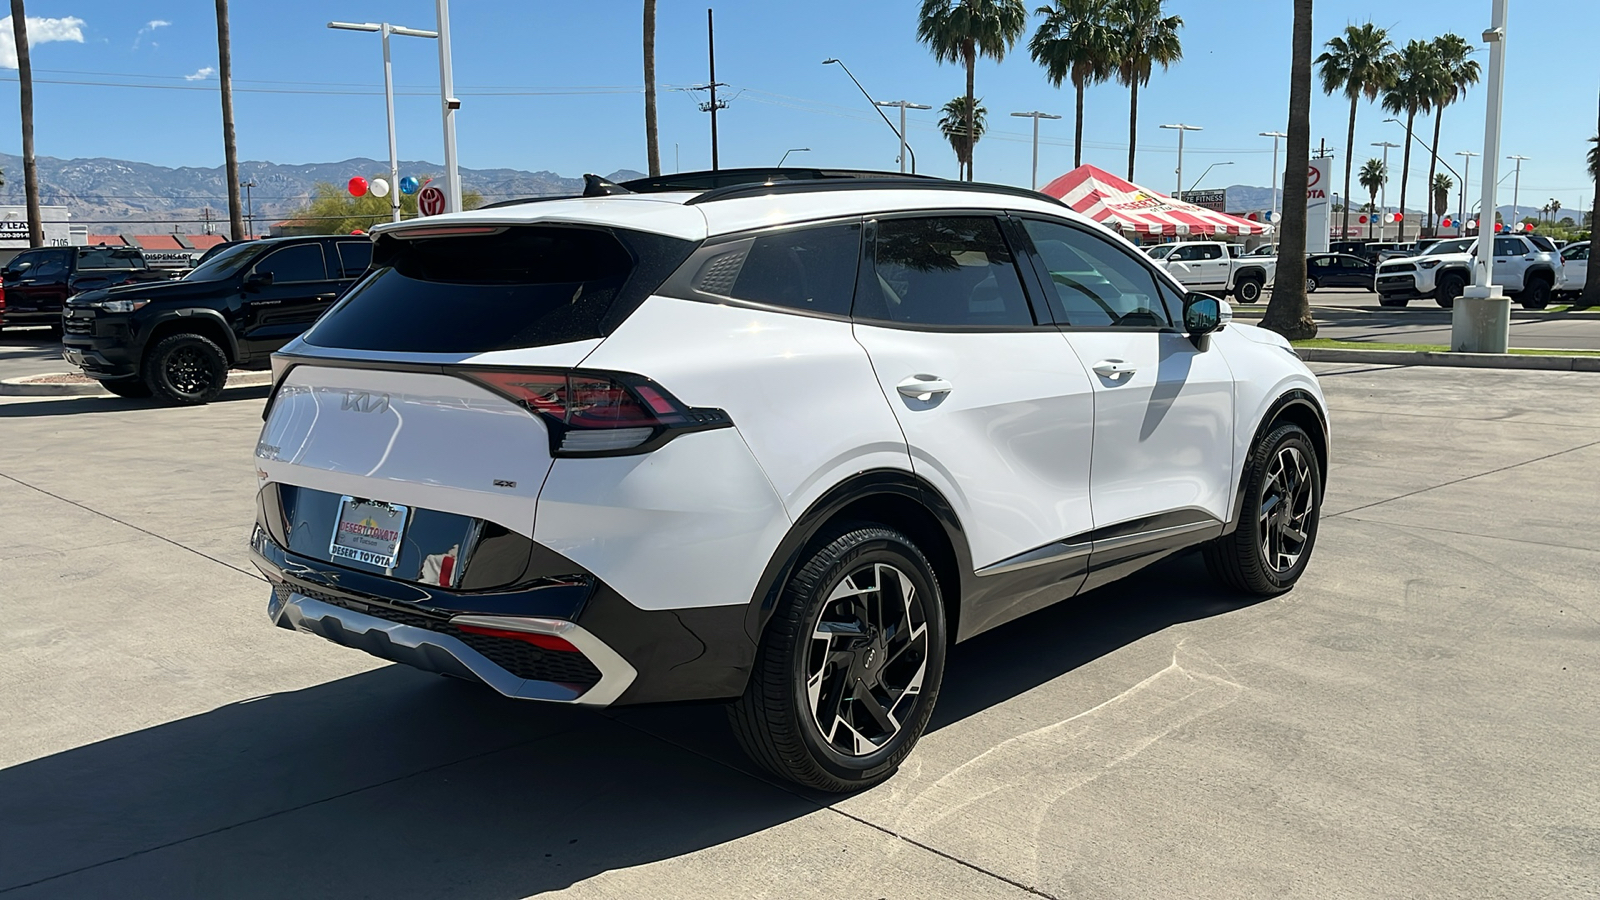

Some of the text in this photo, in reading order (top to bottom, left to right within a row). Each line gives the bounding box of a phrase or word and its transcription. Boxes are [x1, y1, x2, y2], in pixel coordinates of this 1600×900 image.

[1195, 194, 1223, 202] FITNESS
[51, 238, 69, 247] 7105
[341, 391, 390, 414] KIA
[340, 521, 399, 542] DESERT TOYOTA
[359, 537, 378, 546] Tucson
[332, 545, 390, 567] DESERT TOYOTA
